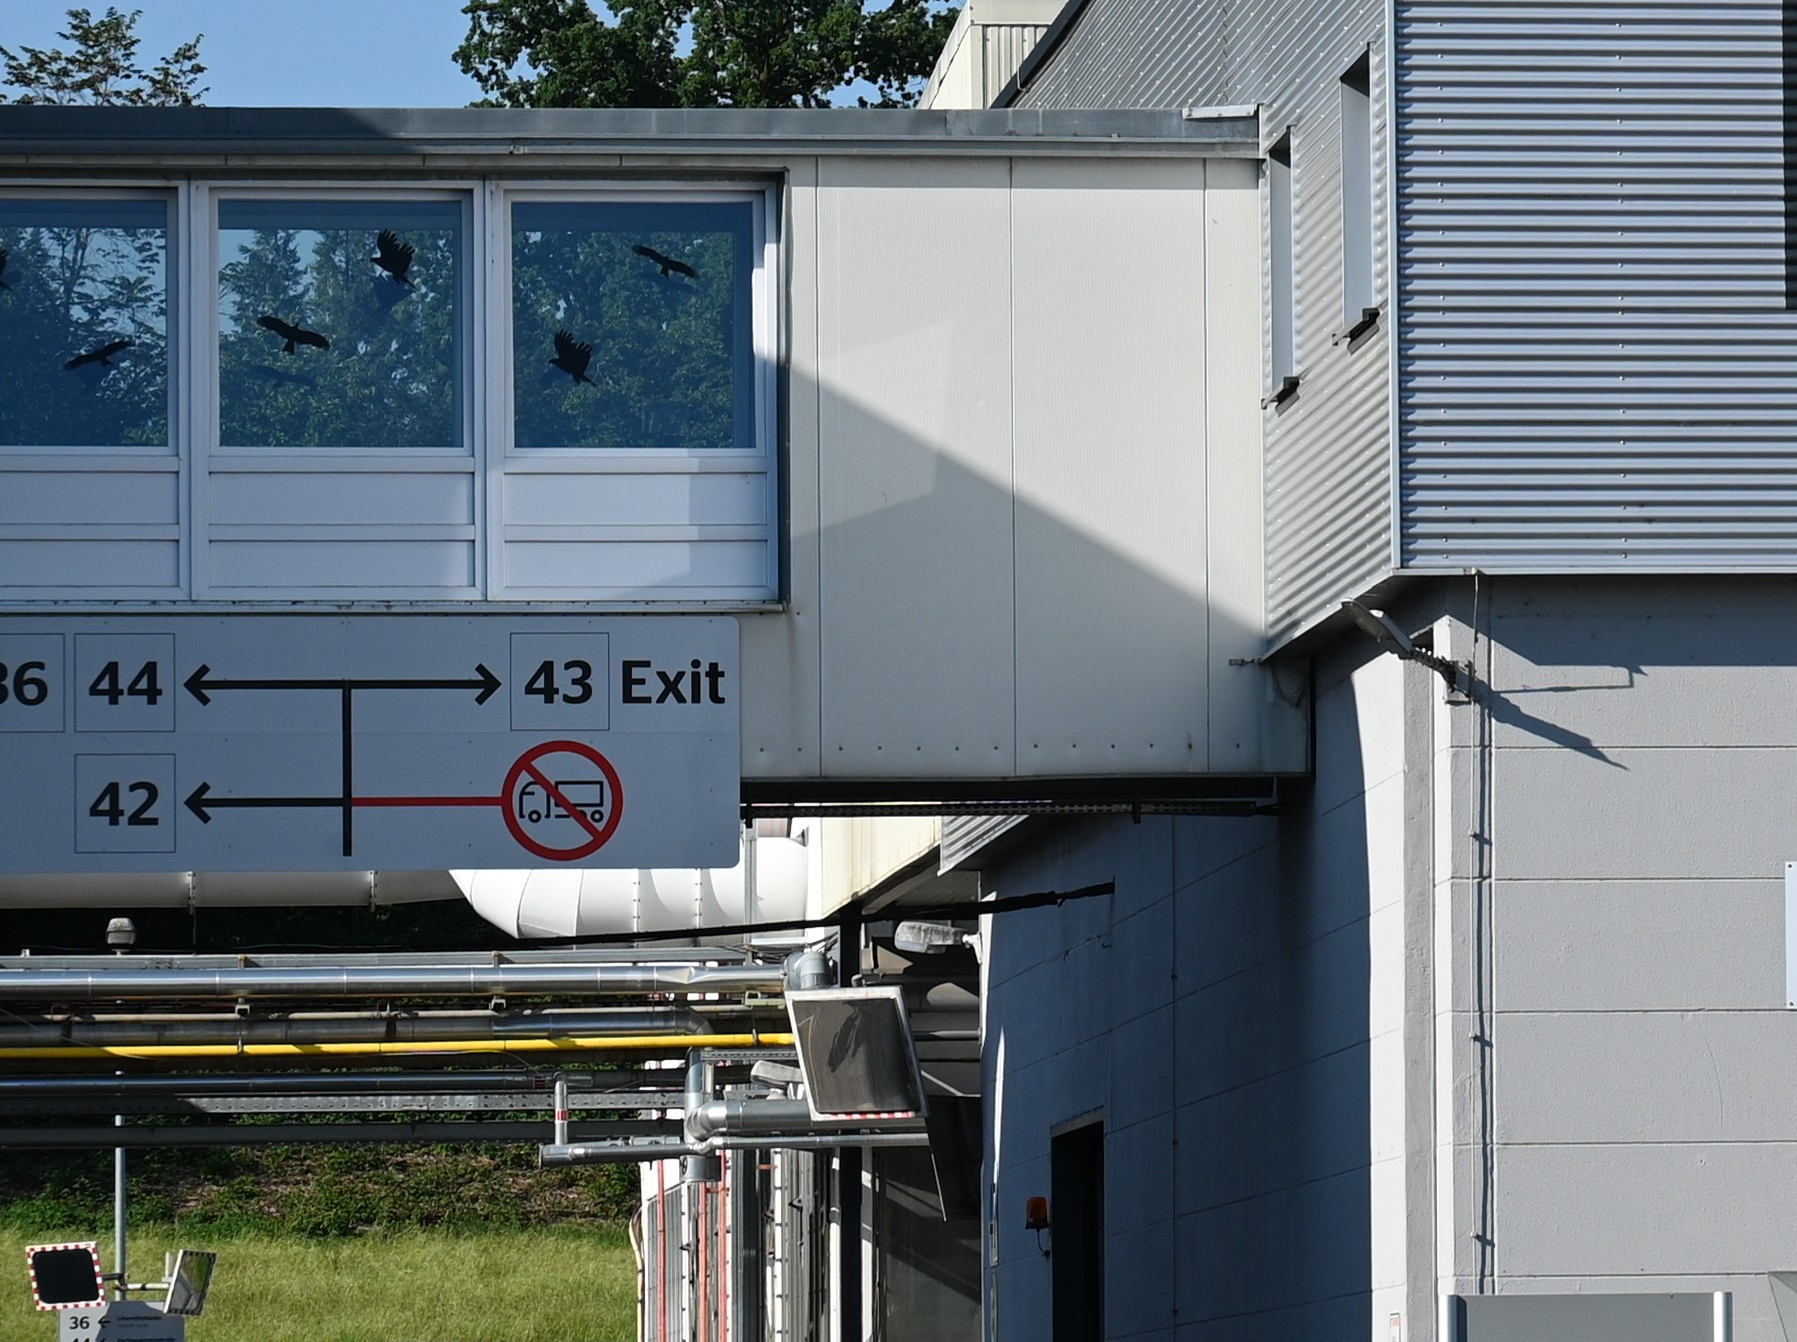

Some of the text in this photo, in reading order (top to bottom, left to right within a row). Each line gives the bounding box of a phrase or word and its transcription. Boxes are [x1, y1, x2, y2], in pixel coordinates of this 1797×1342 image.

[88, 661, 163, 706] 44
[524, 660, 726, 705] 43 Exit
[88, 781, 160, 827] 42
[69, 1316, 90, 1330] 36
